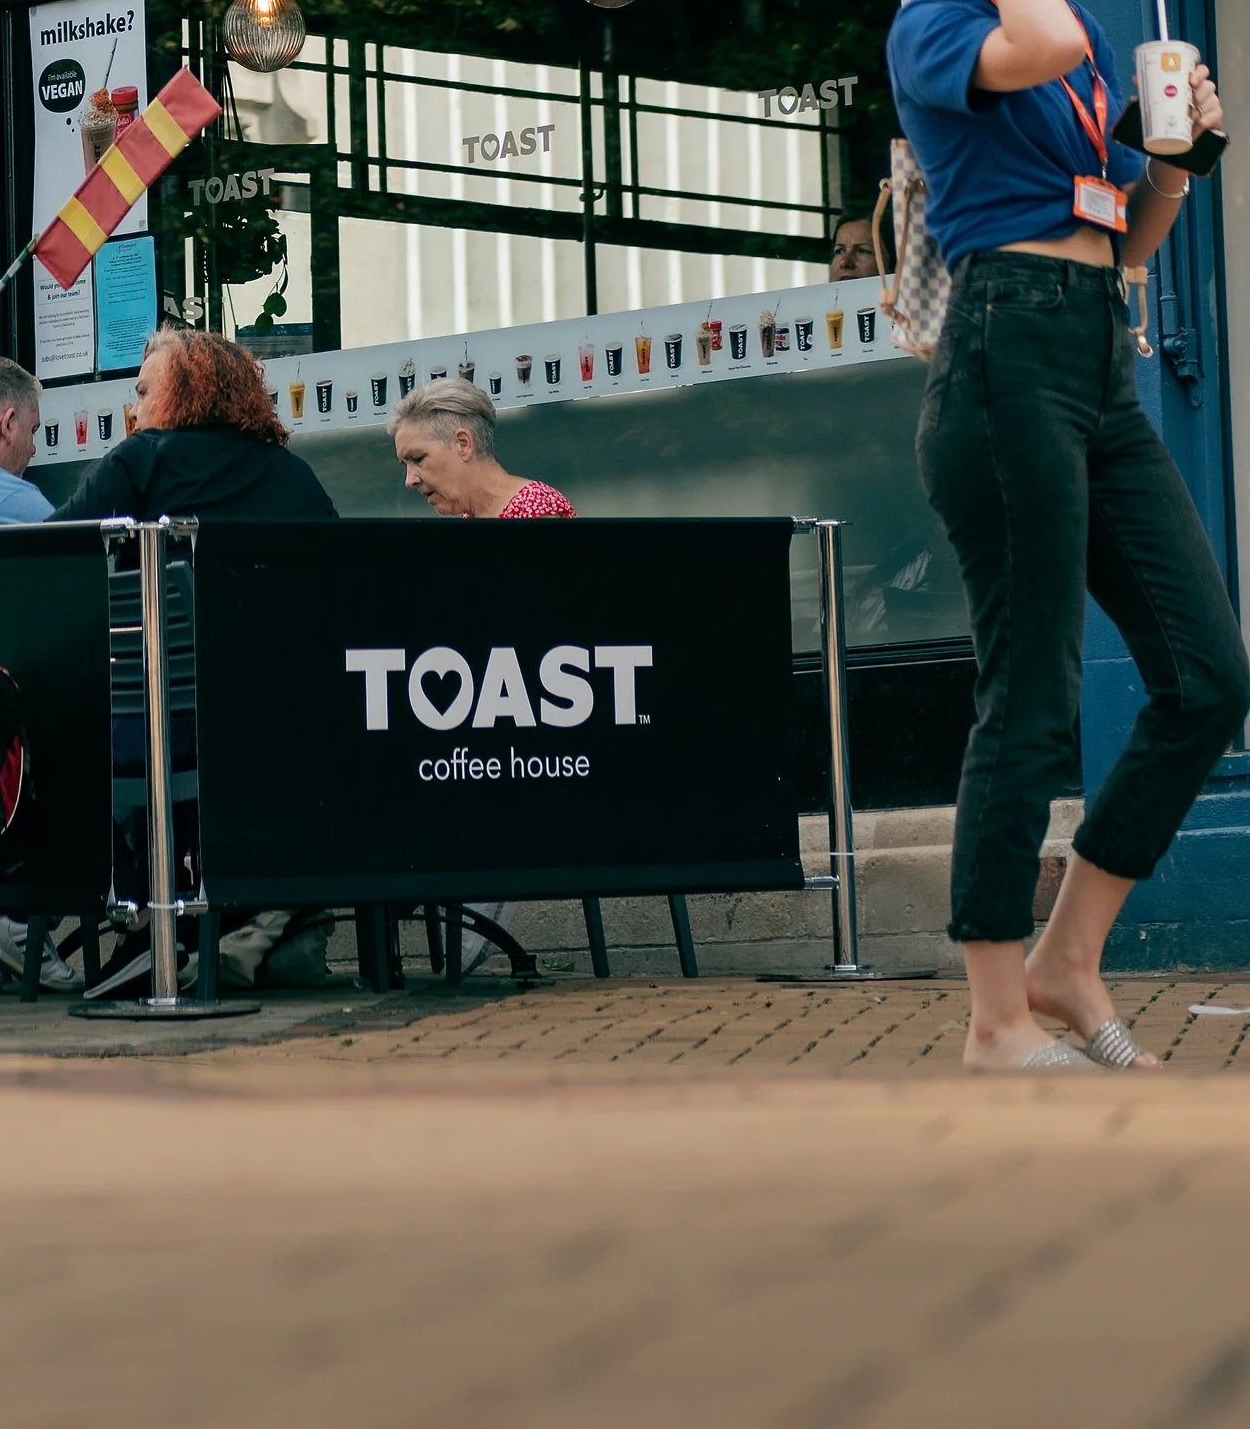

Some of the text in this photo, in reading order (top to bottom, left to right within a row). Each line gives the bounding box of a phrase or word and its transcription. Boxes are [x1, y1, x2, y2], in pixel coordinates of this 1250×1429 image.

[40, 10, 135, 46] milkshake?
[41, 80, 83, 101] VEGAN
[758, 76, 858, 118] TOAST
[462, 124, 555, 164] TOAST
[187, 167, 275, 206] TOAST
[51, 293, 60, 301] join
[345, 644, 653, 731] TOAST
[418, 746, 590, 781] coffee house
